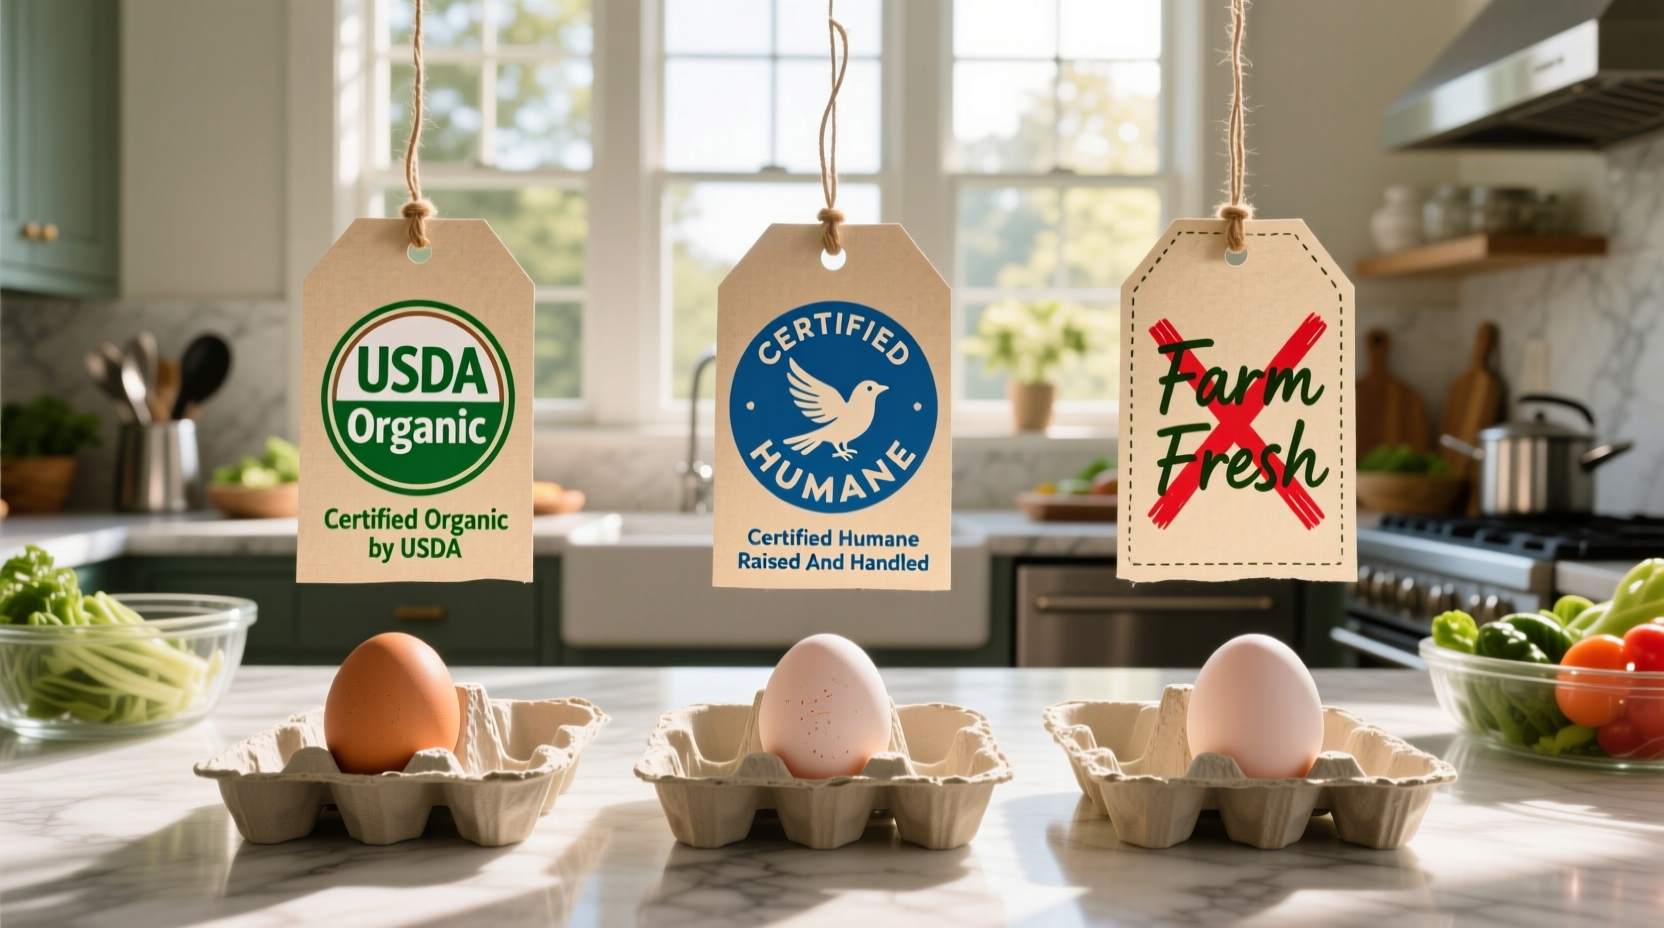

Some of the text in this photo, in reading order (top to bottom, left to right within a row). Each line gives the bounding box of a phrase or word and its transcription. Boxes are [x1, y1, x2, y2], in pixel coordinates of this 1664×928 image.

[758, 312, 909, 365] CERTIFIED
[357, 345, 488, 394] USDA
[1157, 338, 1325, 416] Farm
[347, 407, 486, 454] Organic
[750, 439, 916, 503] HUMANE
[1156, 419, 1330, 496] Fresh
[324, 508, 509, 536] Certified Organic
[747, 527, 919, 547] Certified Humane
[368, 537, 462, 563] by USDA
[738, 552, 929, 571] Raised And Handled
